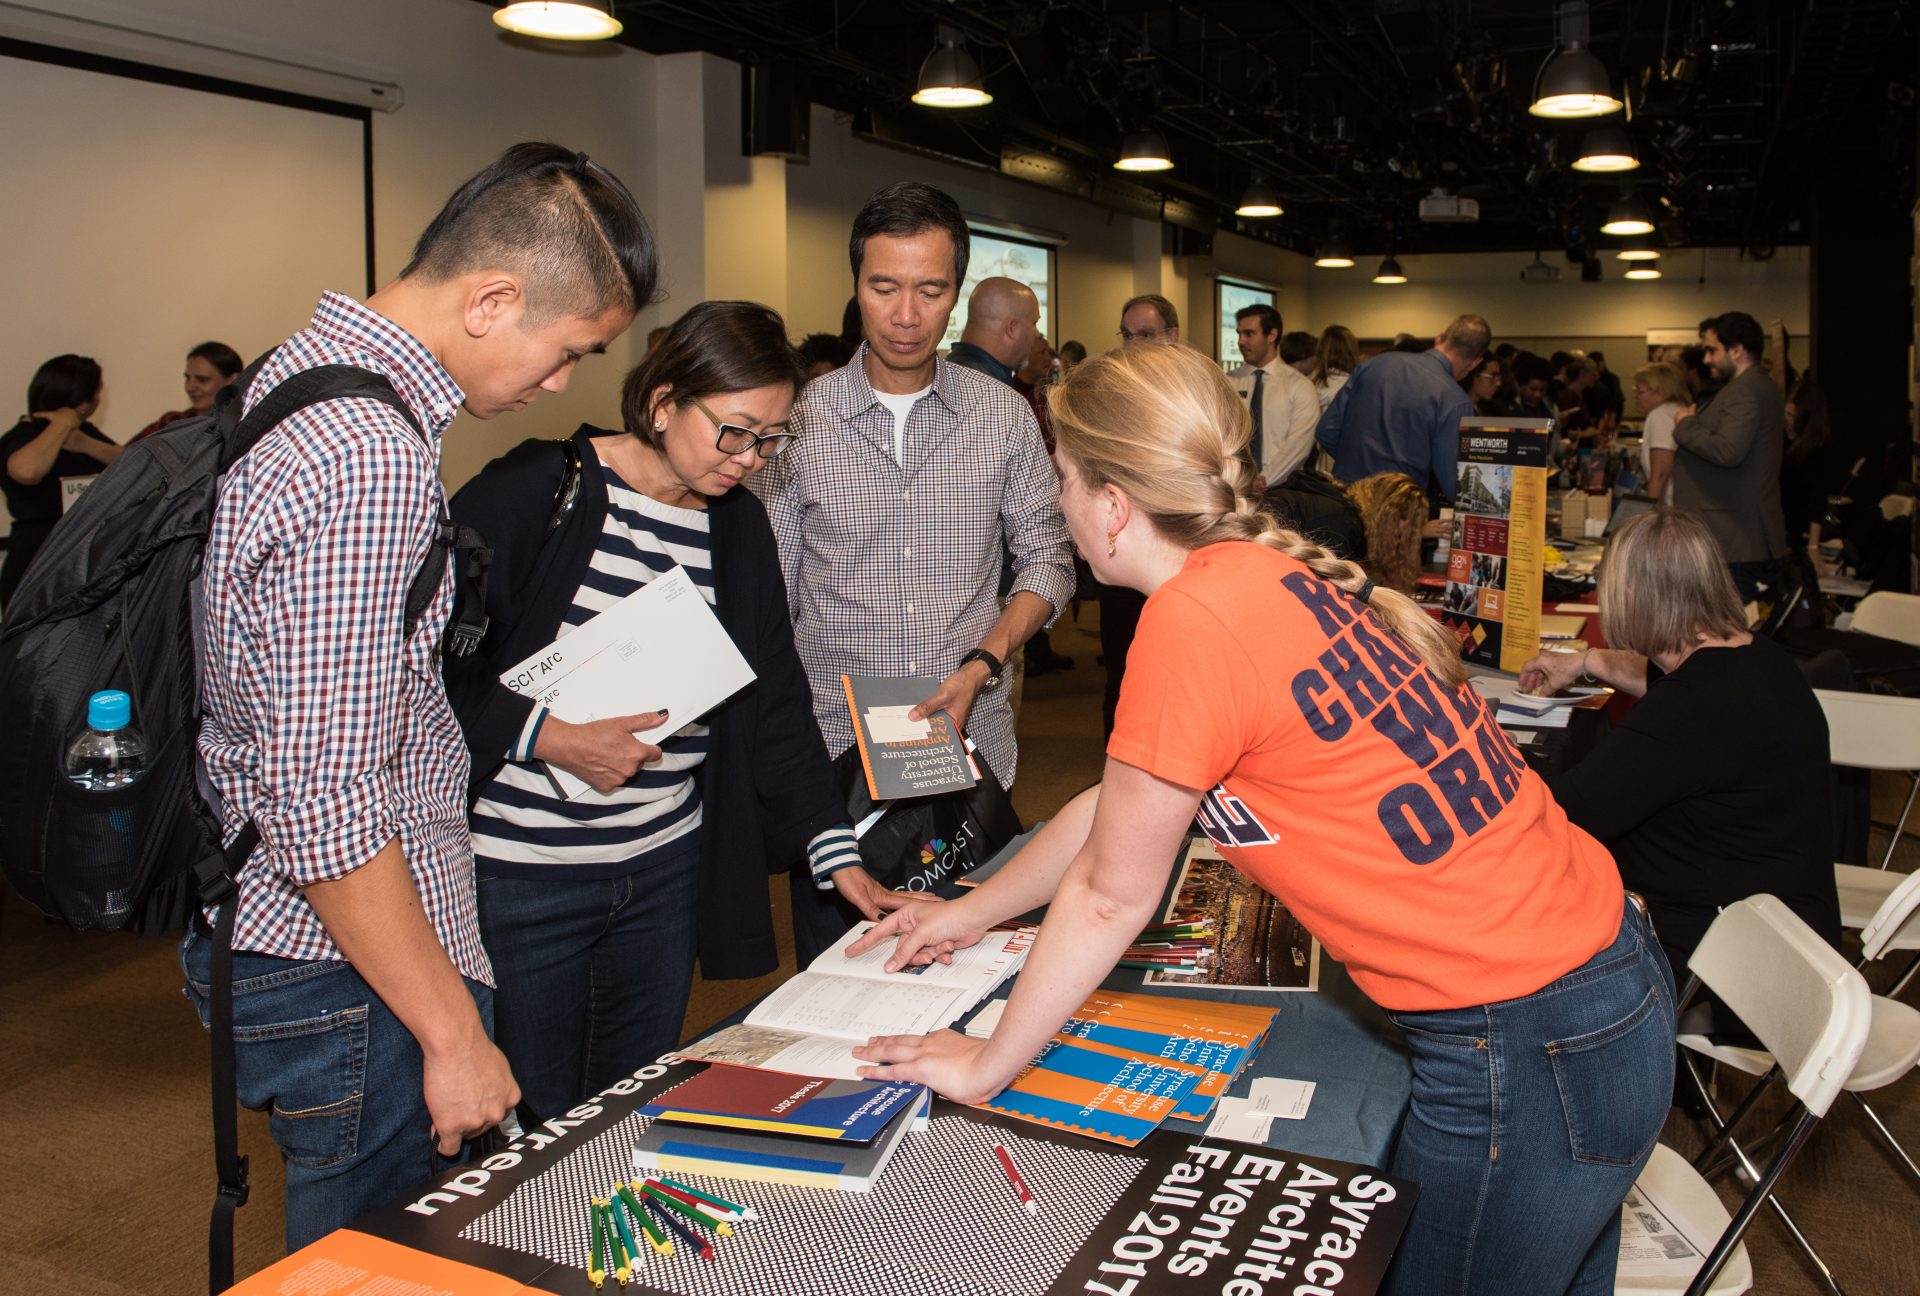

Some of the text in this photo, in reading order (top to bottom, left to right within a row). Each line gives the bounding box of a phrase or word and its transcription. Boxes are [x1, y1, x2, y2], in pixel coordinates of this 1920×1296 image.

[1470, 438, 1508, 449] WENTWORTH
[1451, 554, 1467, 569] 98%
[881, 745, 954, 759] Architecture
[904, 754, 959, 770] School of
[901, 765, 963, 780] University
[912, 774, 966, 789] Syracuse
[895, 820, 974, 893] OMCAST
[1122, 1061, 1162, 1095] School
[1202, 1041, 1239, 1087] Syracuse
[770, 1080, 823, 1113] Thesis 2017
[842, 1086, 896, 1126] Architecture
[871, 1087, 912, 1116] Syracuse
[1079, 1056, 1144, 1117] Architecture
[1123, 1066, 1180, 1115] University
[1148, 1069, 1196, 1112] Syracuse
[404, 1051, 688, 1217] soa.syr.edu
[1149, 1144, 1232, 1208] Fall
[1167, 1154, 1286, 1277] Events
[1083, 1210, 1181, 1296] 2017
